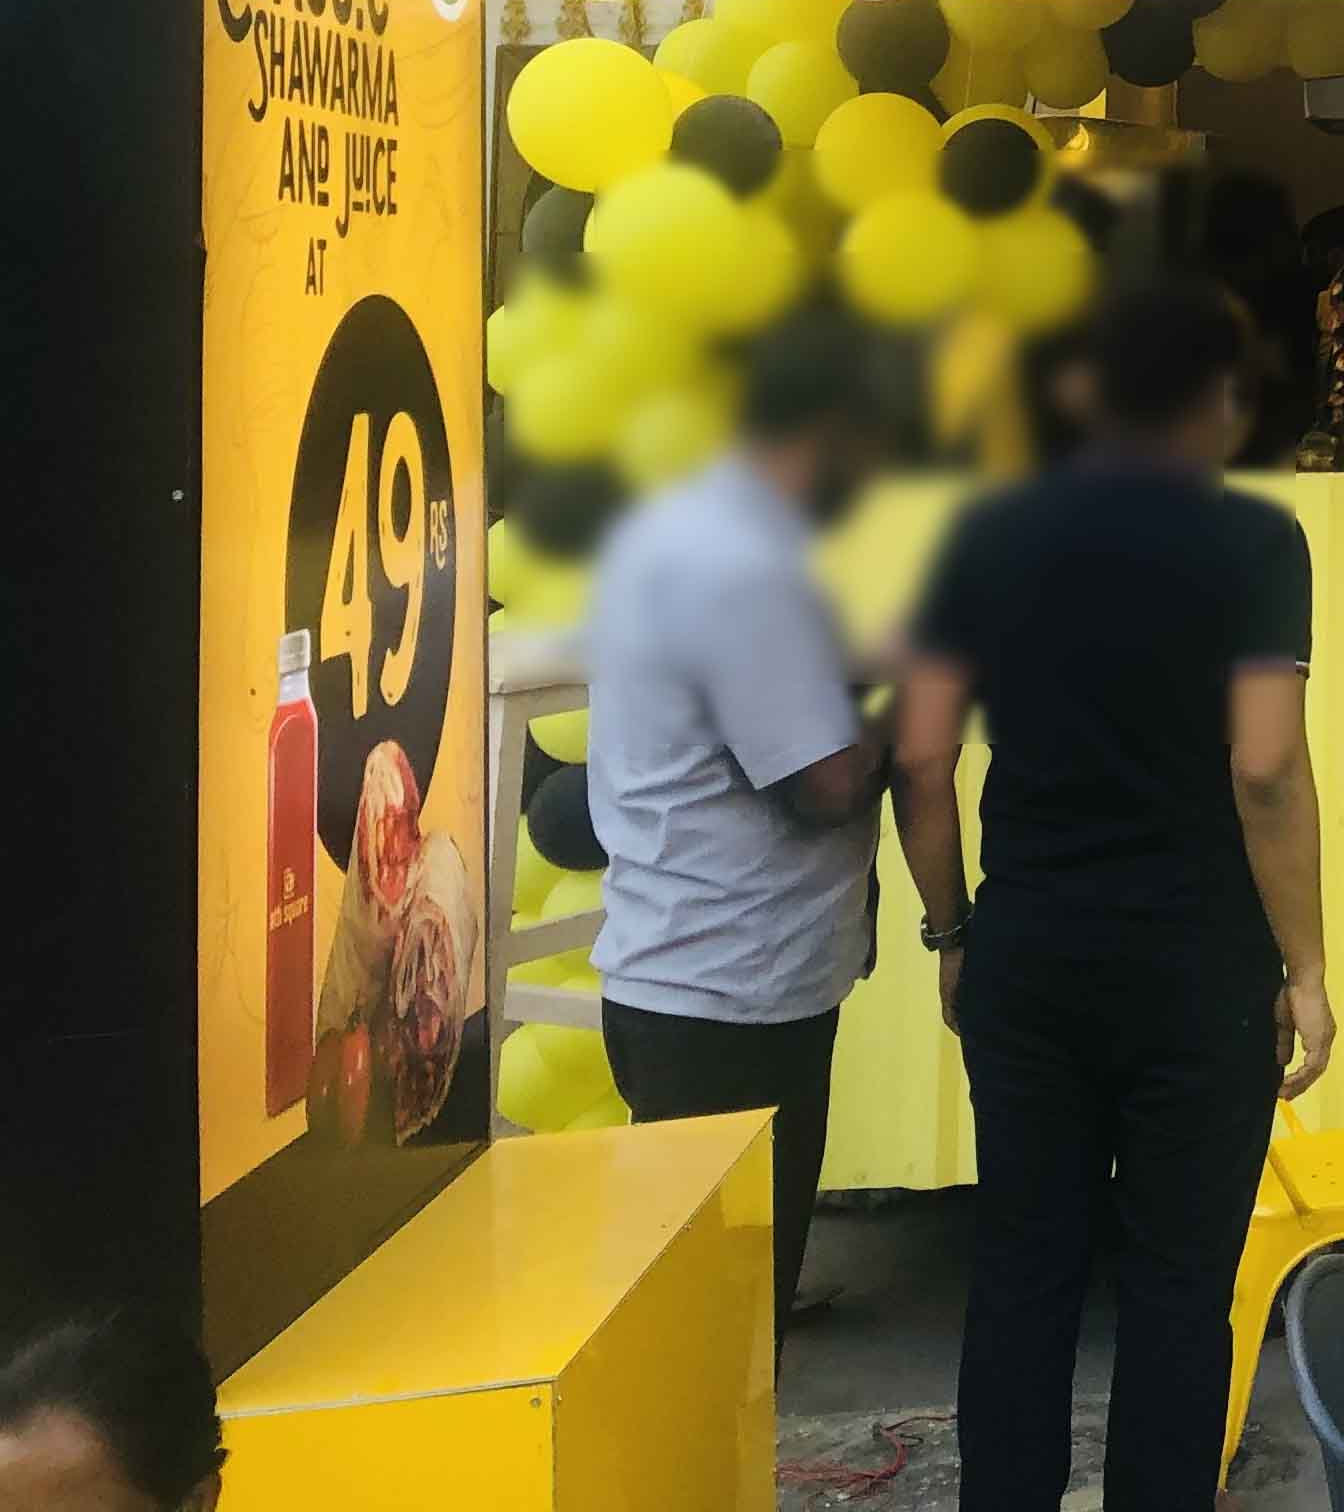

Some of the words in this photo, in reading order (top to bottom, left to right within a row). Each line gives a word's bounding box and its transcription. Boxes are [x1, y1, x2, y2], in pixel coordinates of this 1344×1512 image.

[248, 10, 400, 127] SHAWARMA
[278, 116, 330, 207] AND
[335, 131, 399, 239] JUICE
[304, 236, 328, 296] AT
[319, 411, 425, 720] 49
